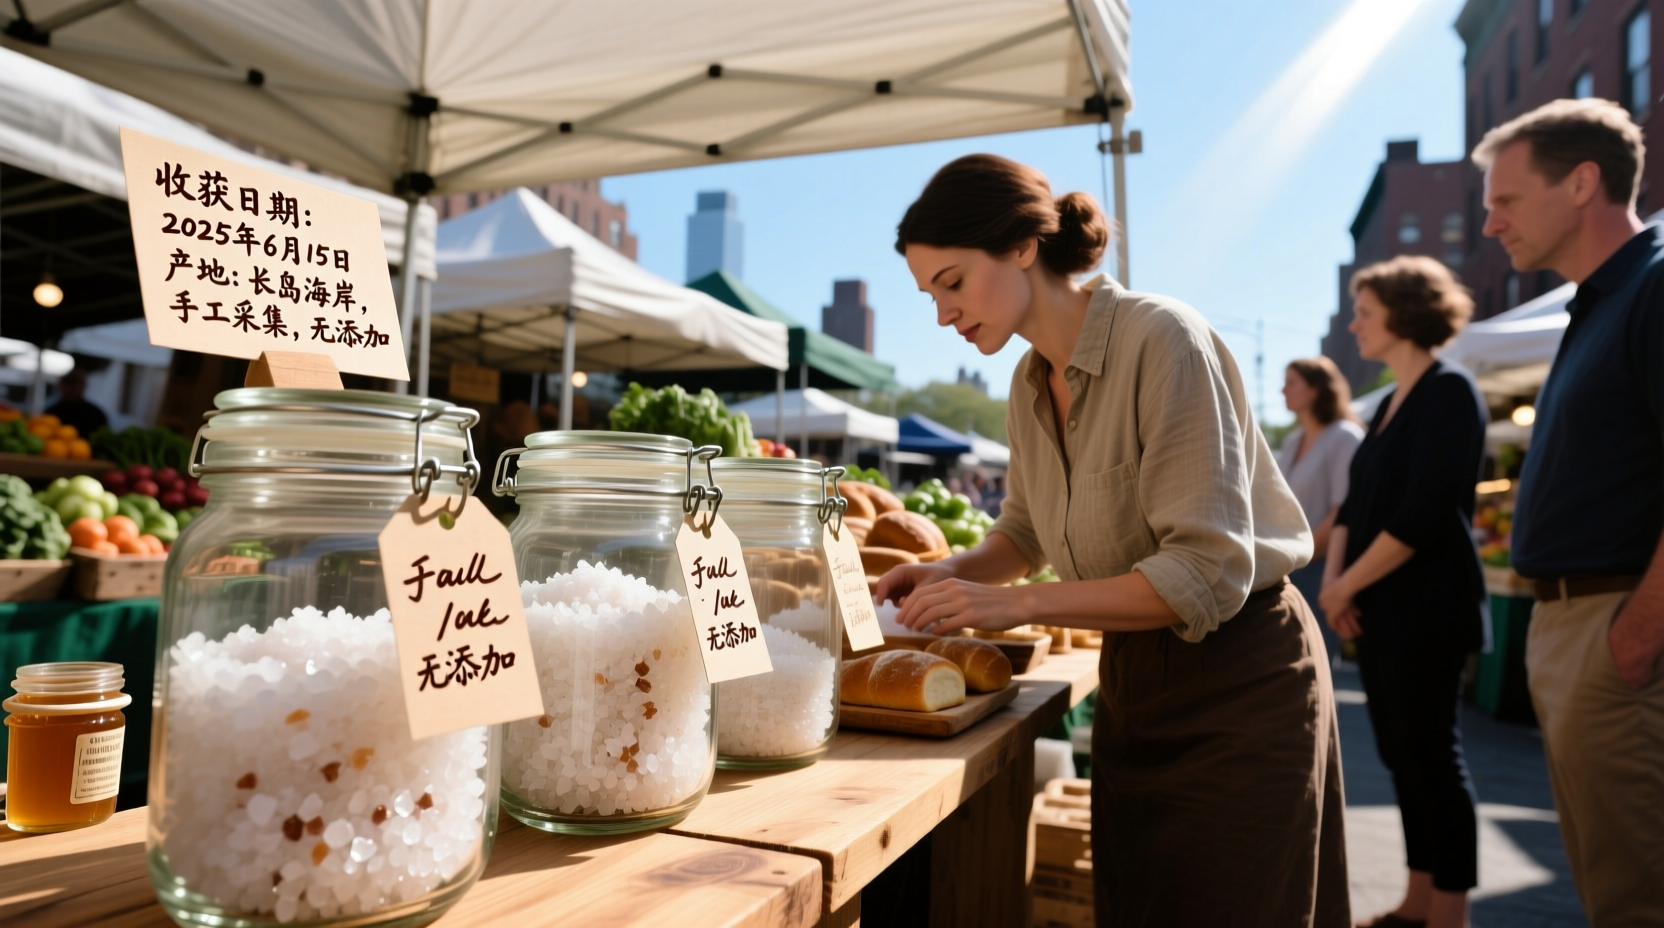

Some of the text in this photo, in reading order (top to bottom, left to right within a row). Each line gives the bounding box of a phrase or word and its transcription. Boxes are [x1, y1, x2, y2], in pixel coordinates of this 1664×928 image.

[155, 161, 313, 229] 收获日期：
[161, 212, 350, 273] 2025年6月15日
[169, 290, 390, 348] 手工采集，无添加
[706, 621, 758, 651] 无添加
[417, 644, 517, 692] 无添加
